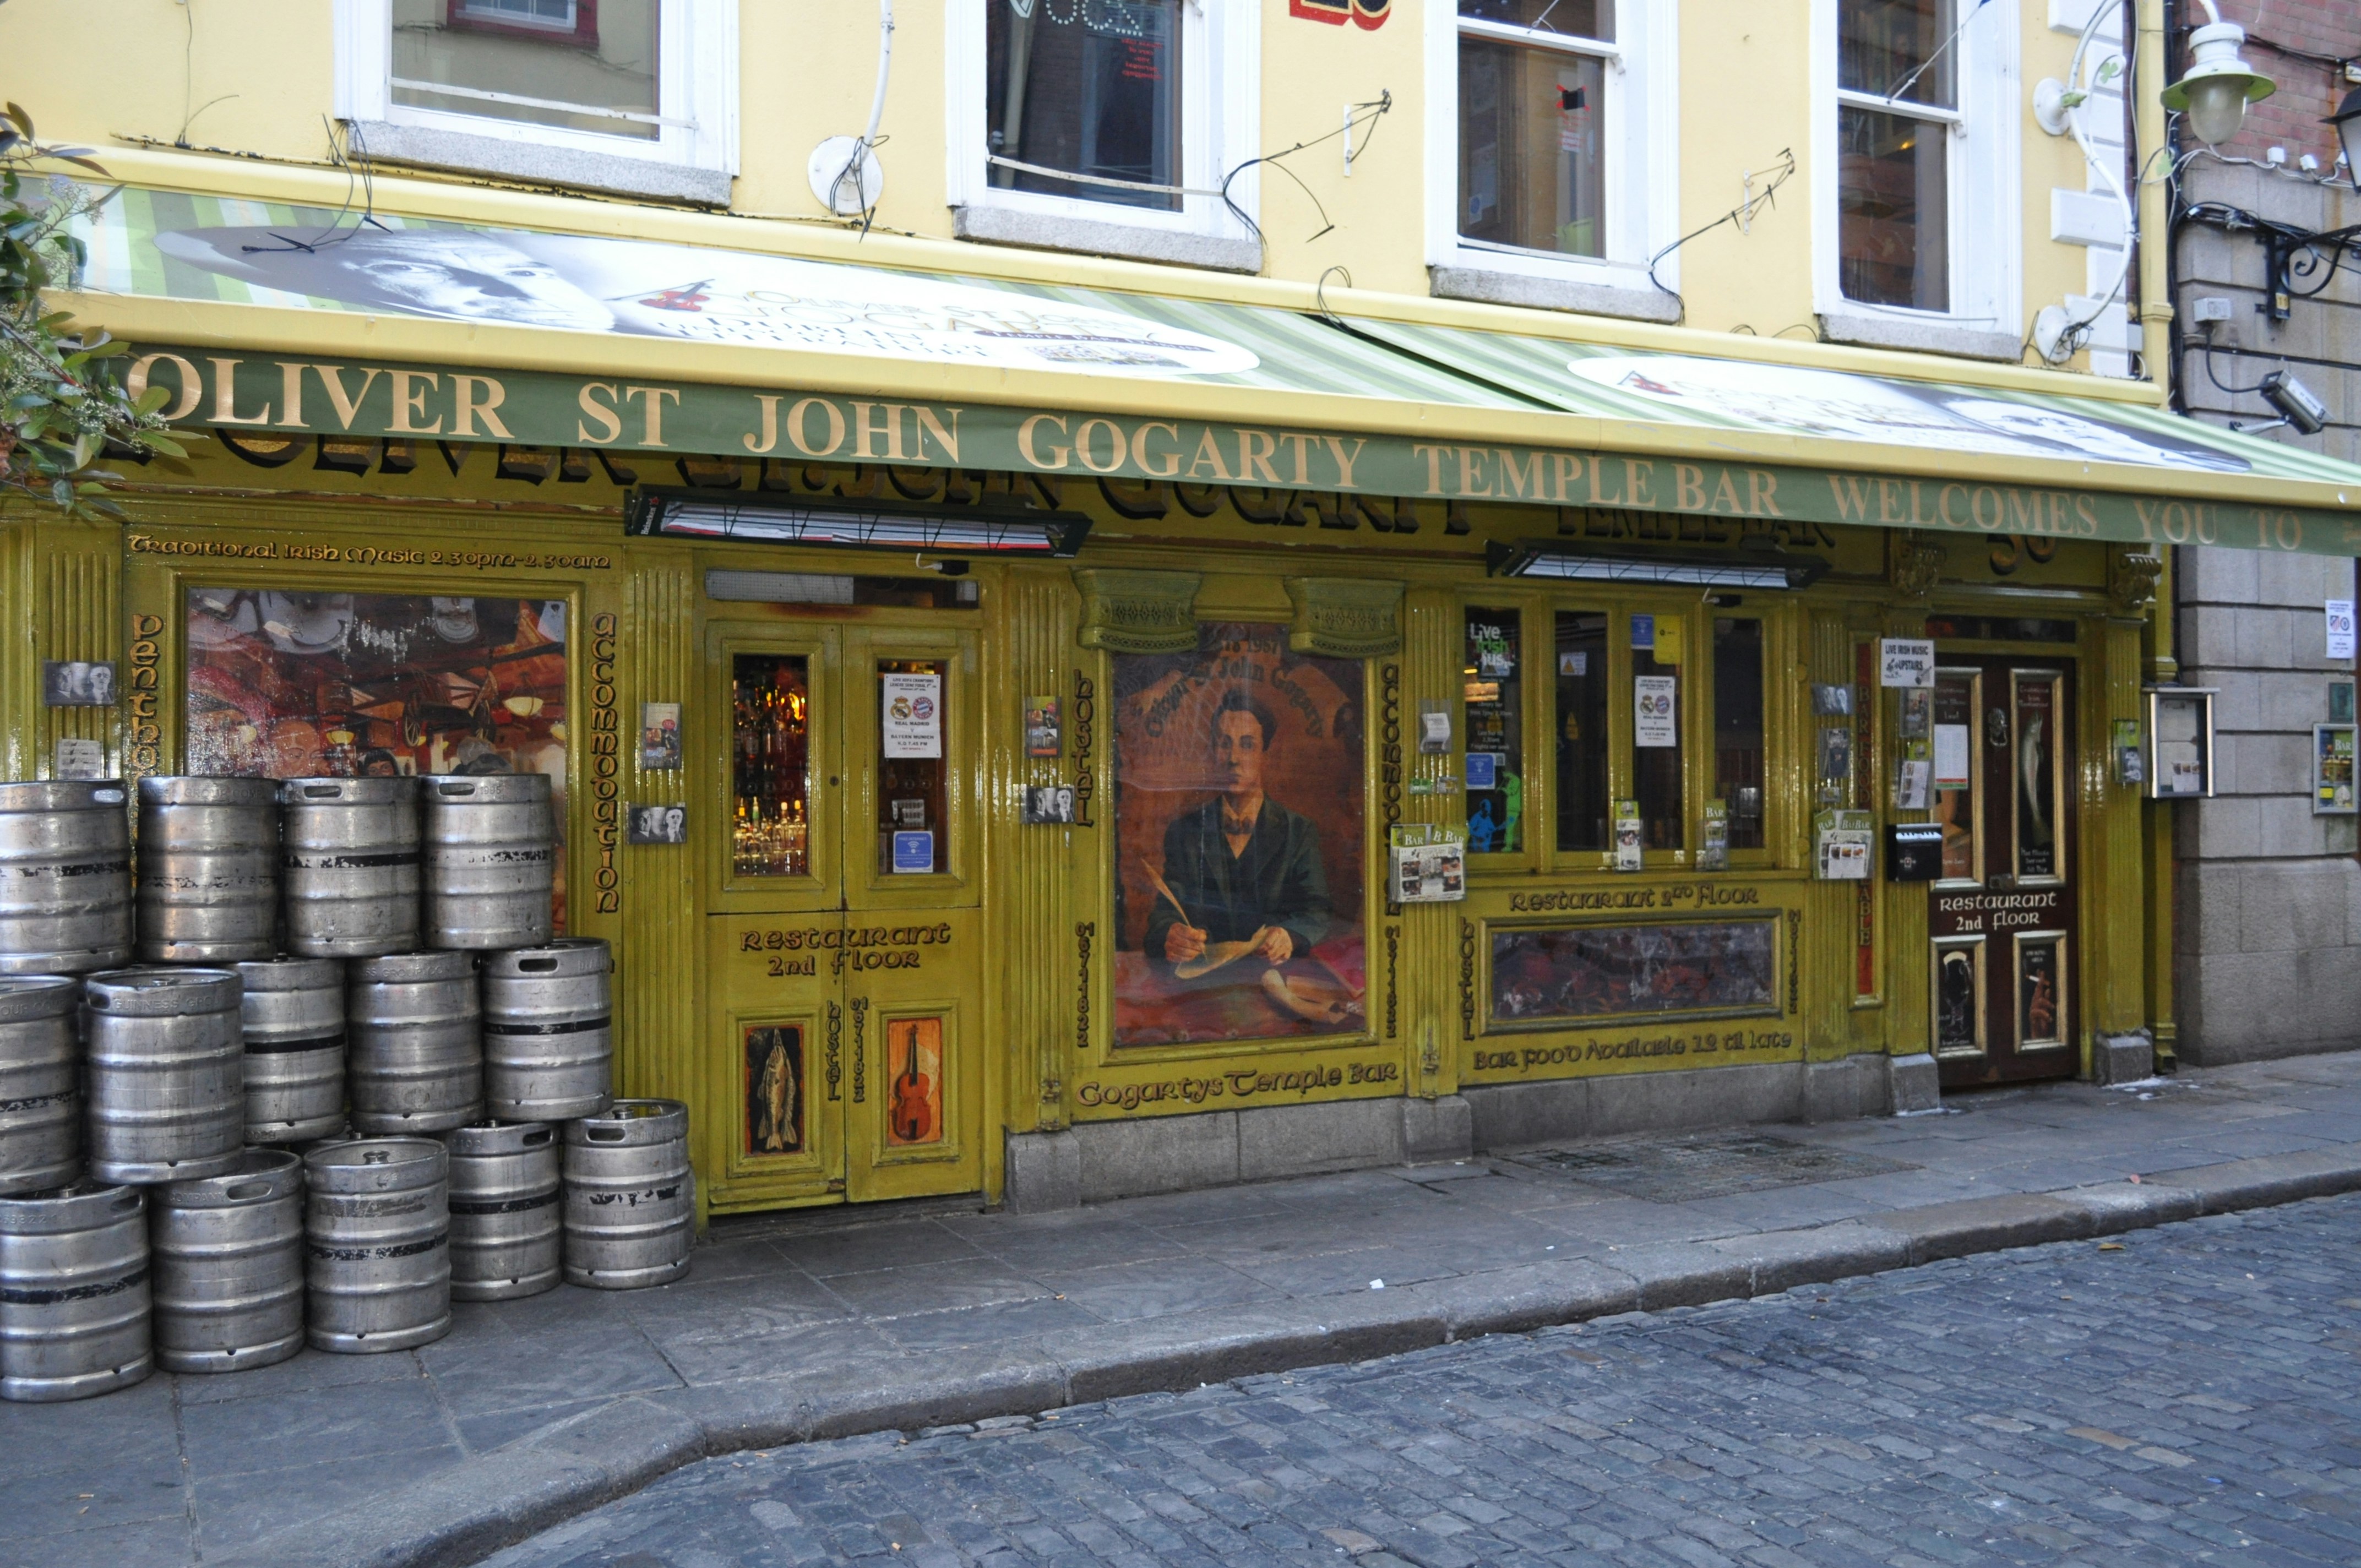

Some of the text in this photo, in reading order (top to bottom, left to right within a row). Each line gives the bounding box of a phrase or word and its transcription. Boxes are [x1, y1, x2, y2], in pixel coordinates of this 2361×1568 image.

[127, 352, 515, 439] OLIVER
[578, 382, 680, 447] ST
[743, 394, 963, 464] JOHN
[1017, 414, 1367, 488] GOGARTY
[1413, 443, 1656, 508] TEMPLE
[1672, 463, 1783, 516] BAR
[1826, 475, 2098, 536] WELCOMES
[2132, 499, 2218, 545] YOU
[2250, 509, 2303, 549] TO
[127, 533, 279, 559] Traditional
[284, 542, 340, 561] Irish
[345, 546, 424, 565] Music
[1885, 645, 1897, 654] LIVE
[1912, 645, 1928, 655] MUSIC
[2335, 738, 2353, 752] BAR
[1705, 807, 1724, 818] BAR
[1405, 834, 1424, 846] BAR
[1509, 886, 1655, 912] Restaurant
[1939, 890, 2057, 912] Restaurant
[1955, 916, 1982, 932] 2nd
[739, 922, 951, 951] Restaurant
[768, 955, 816, 977] 2nd
[112, 997, 179, 1010] GUINNESS
[1473, 1050, 1518, 1071] Bar
[1074, 1061, 1398, 1110] Gogartys Temple Bar
